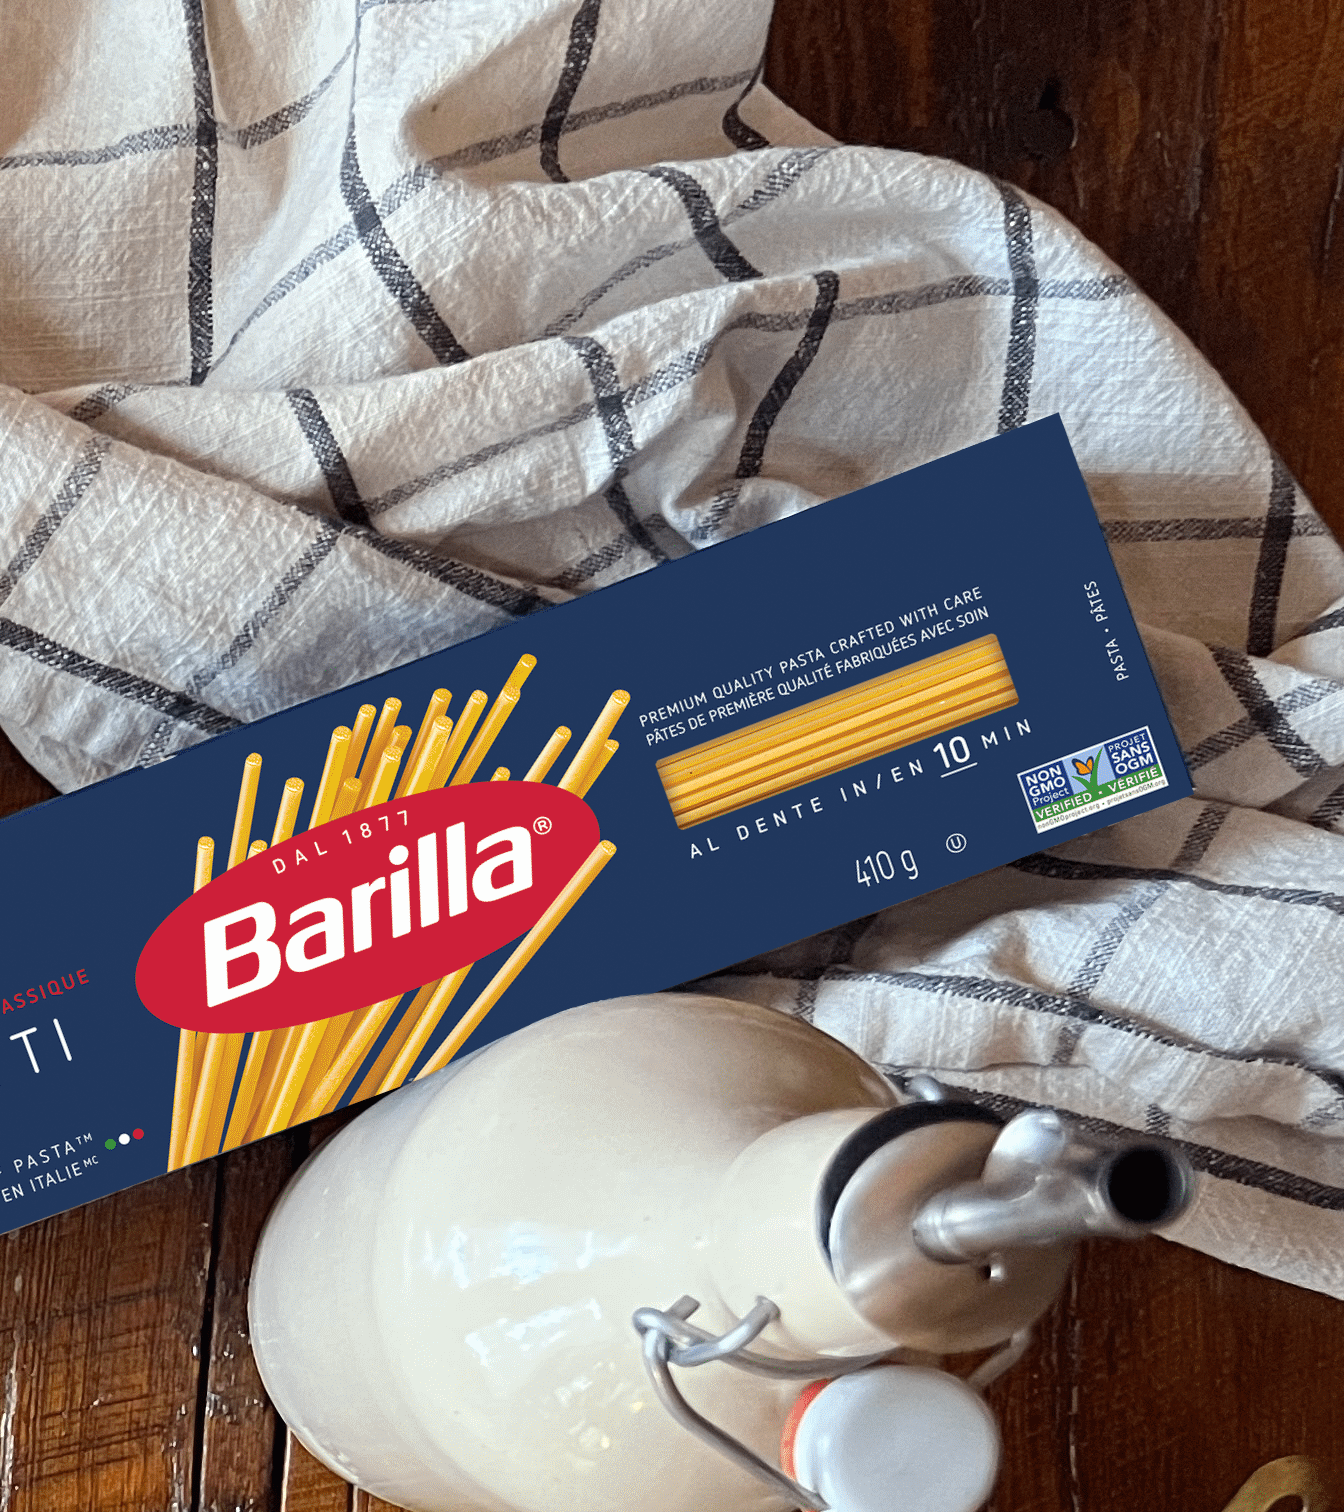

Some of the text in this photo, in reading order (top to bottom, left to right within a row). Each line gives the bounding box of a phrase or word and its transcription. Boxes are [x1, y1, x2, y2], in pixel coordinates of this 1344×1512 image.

[1083, 580, 1130, 682] PASTA PÂTES
[639, 586, 983, 728] PREMIUM QUALITY PASTA CRAFTED WITH CARE
[645, 606, 989, 746] PÂTES DE PREMIÈRE QUALITÉ FABRIQUÉES AVEC SOIN
[1108, 732, 1147, 753] PROJET
[1111, 740, 1151, 764] SANS
[1025, 765, 1062, 787] NON
[1115, 753, 1154, 775] OGM
[691, 837, 720, 859] AL
[736, 796, 823, 841] DENTE
[932, 735, 971, 769] 10
[980, 718, 1031, 750] MIN
[1028, 776, 1066, 797] GMO
[1032, 787, 1070, 806] Project
[1035, 792, 1093, 819] VERIFIED
[271, 809, 408, 875] DAL 1877
[855, 850, 895, 887] 410
[900, 849, 919, 880] g
[1, 1183, 24, 1203] EN
